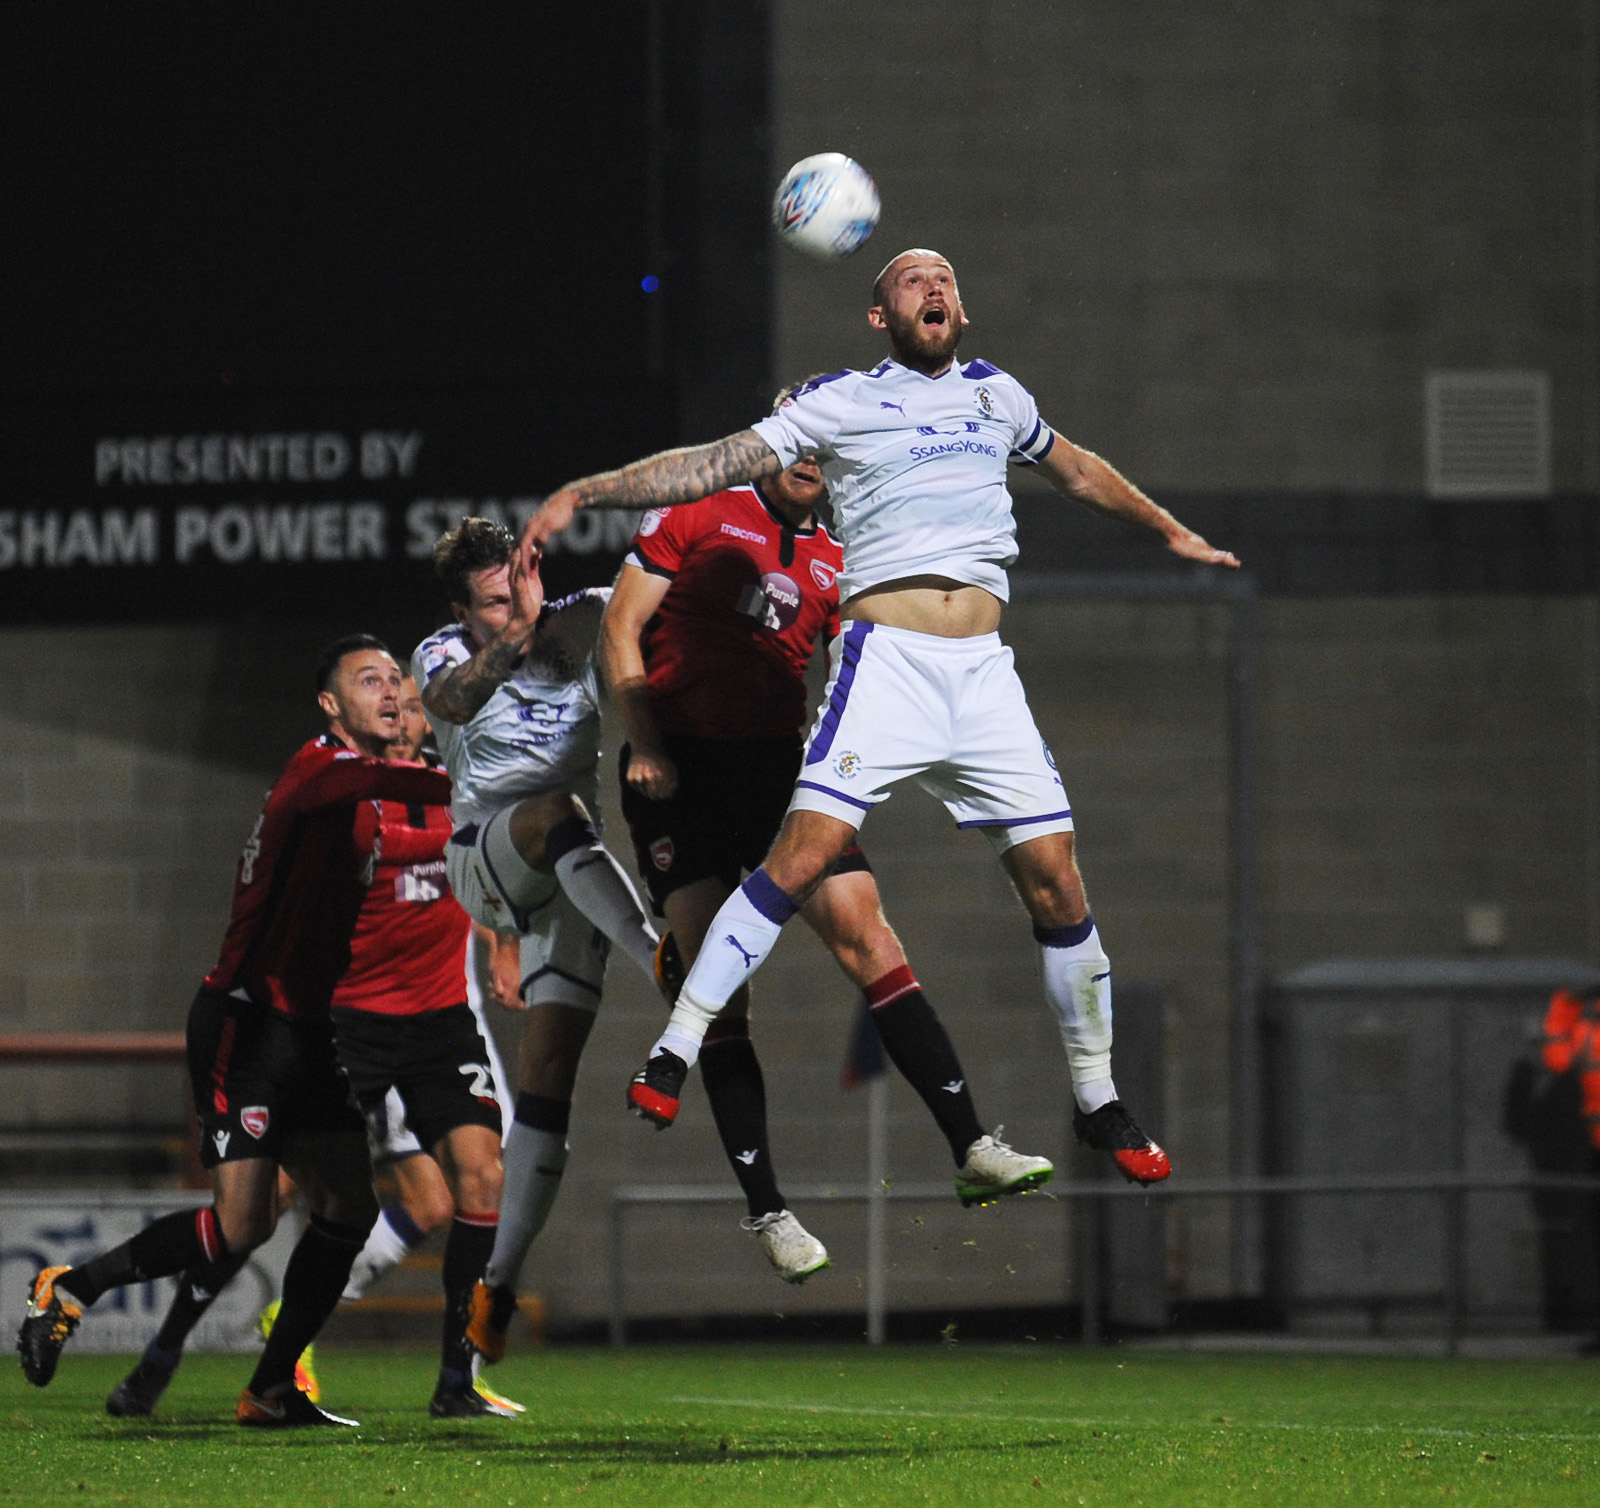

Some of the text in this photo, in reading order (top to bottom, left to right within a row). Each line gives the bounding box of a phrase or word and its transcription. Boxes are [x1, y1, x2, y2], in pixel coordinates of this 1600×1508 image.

[95, 433, 420, 484] PRESENTED BY
[176, 503, 384, 562] POWER
[721, 523, 767, 545] macron
[765, 582, 799, 608] Purple
